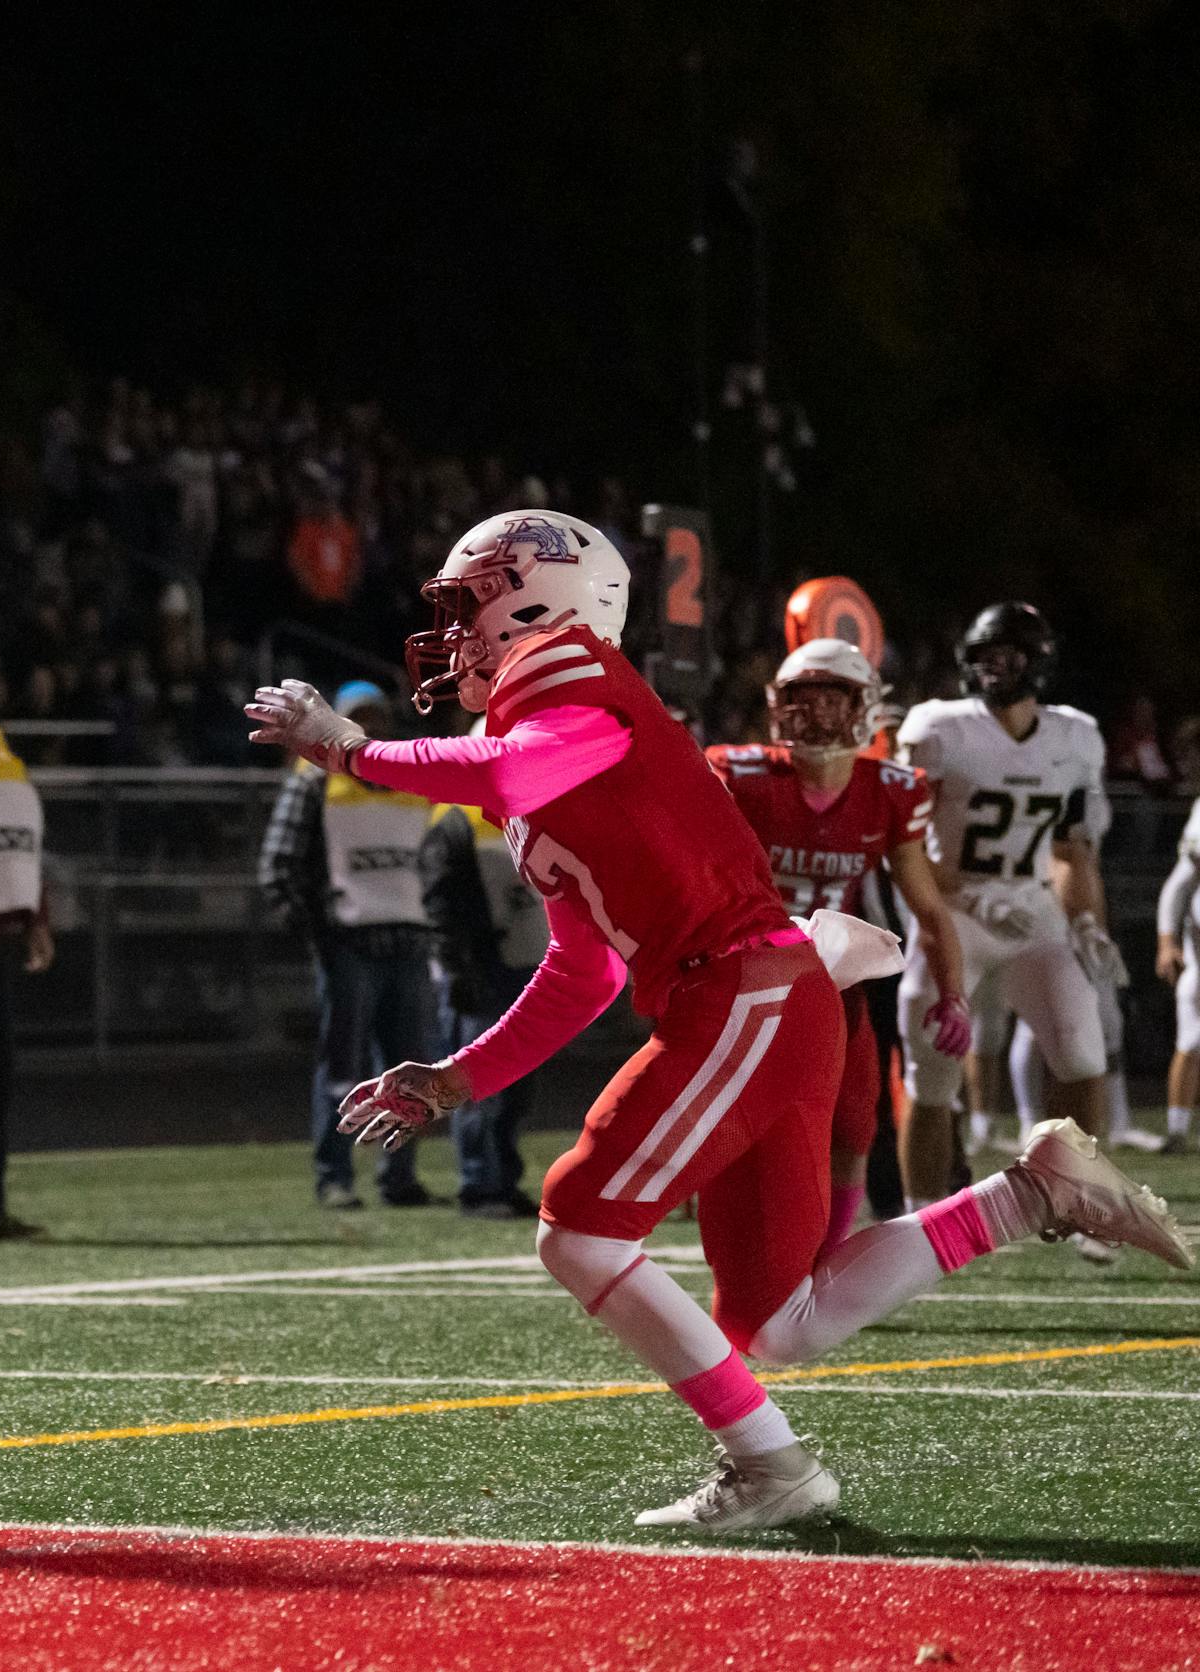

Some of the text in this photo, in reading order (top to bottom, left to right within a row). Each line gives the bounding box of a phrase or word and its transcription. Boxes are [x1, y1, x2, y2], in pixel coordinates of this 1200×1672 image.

[665, 527, 704, 626] 2
[770, 845, 866, 876] FALCONS
[961, 788, 1063, 877] 27
